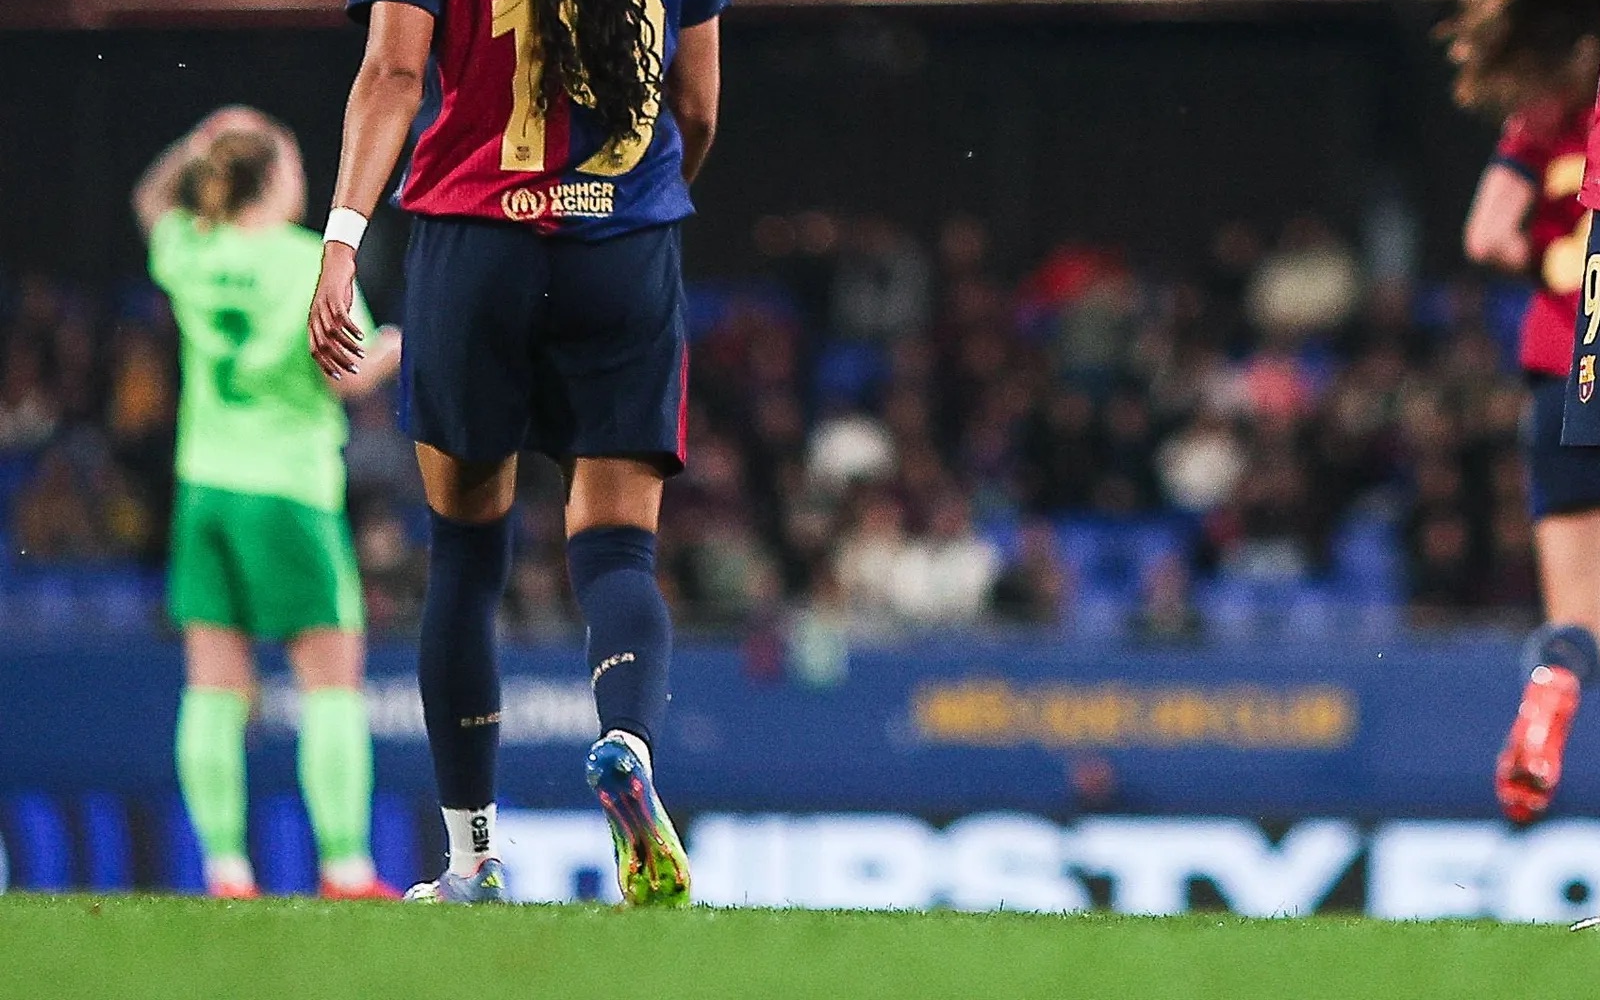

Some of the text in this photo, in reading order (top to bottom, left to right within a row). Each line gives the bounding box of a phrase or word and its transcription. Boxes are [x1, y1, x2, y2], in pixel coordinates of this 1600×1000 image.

[549, 180, 616, 199] UNHCR
[550, 196, 614, 215] ACNUR
[471, 815, 490, 853] NEO
